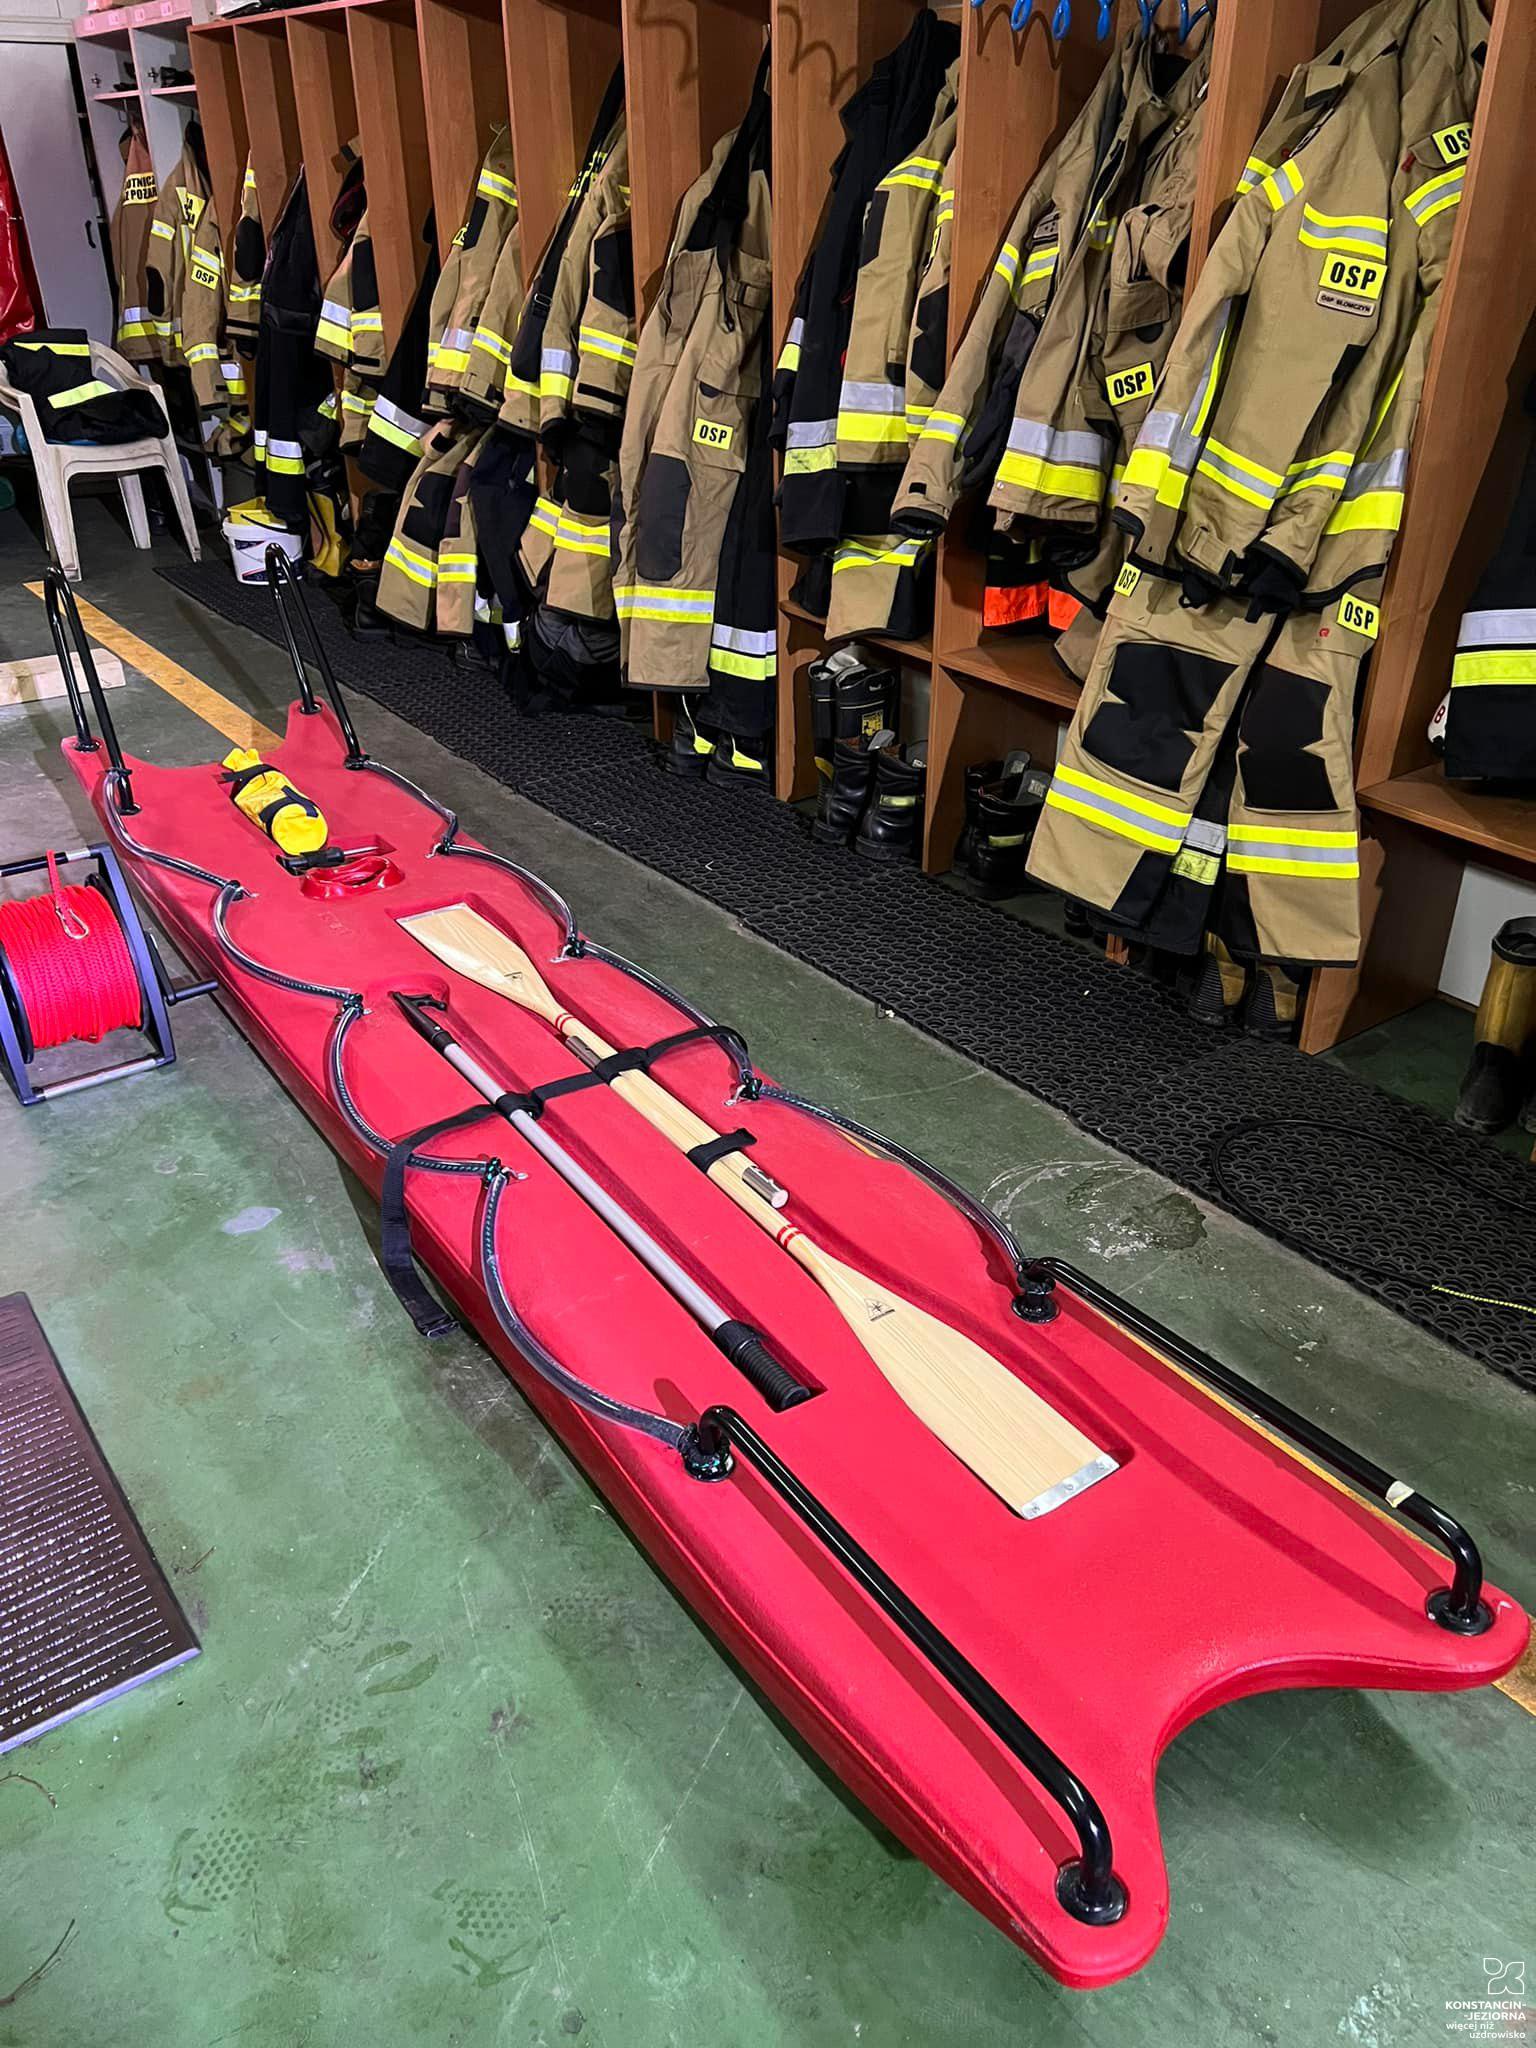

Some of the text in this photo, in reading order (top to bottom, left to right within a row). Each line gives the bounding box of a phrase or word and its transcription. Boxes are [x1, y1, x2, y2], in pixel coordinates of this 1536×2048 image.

[1444, 128, 1472, 155] OS
[195, 270, 215, 283] OSP
[1330, 262, 1377, 290] OSP
[1113, 371, 1147, 398] OSP
[699, 425, 727, 443] OSP
[1118, 568, 1137, 590] OSP
[1344, 601, 1374, 630] OSP
